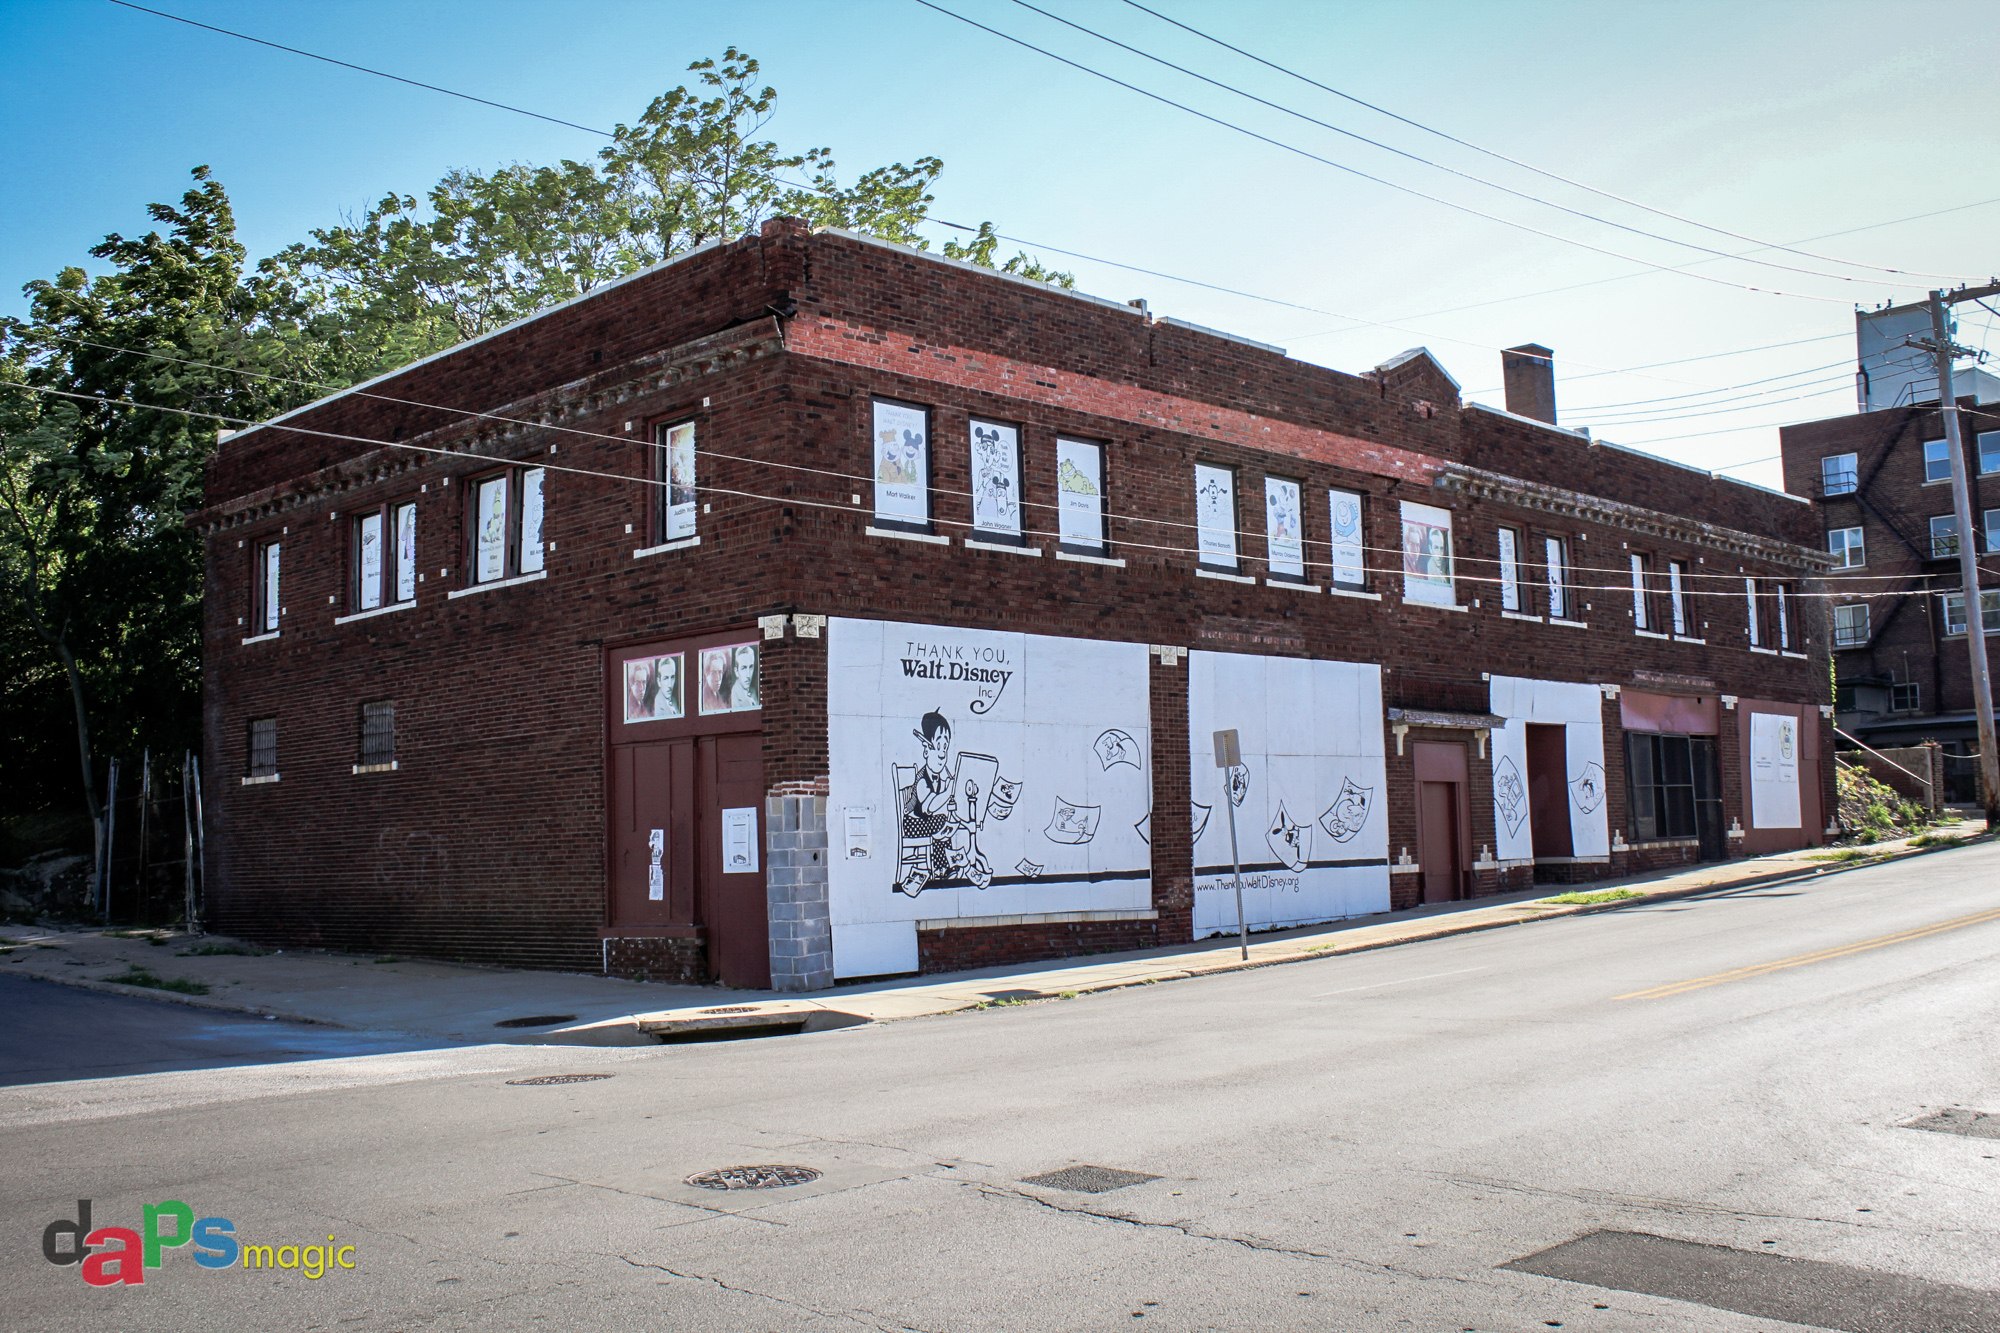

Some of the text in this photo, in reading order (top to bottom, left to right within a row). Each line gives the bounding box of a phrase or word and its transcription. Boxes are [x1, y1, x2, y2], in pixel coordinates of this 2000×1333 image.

[886, 490, 898, 498] Mort
[1271, 550, 1283, 558] Murray
[906, 641, 1010, 665] THANK YOU,
[978, 685, 996, 698] Inc.
[1197, 874, 1299, 893] www.ThankouWaltDisney.org
